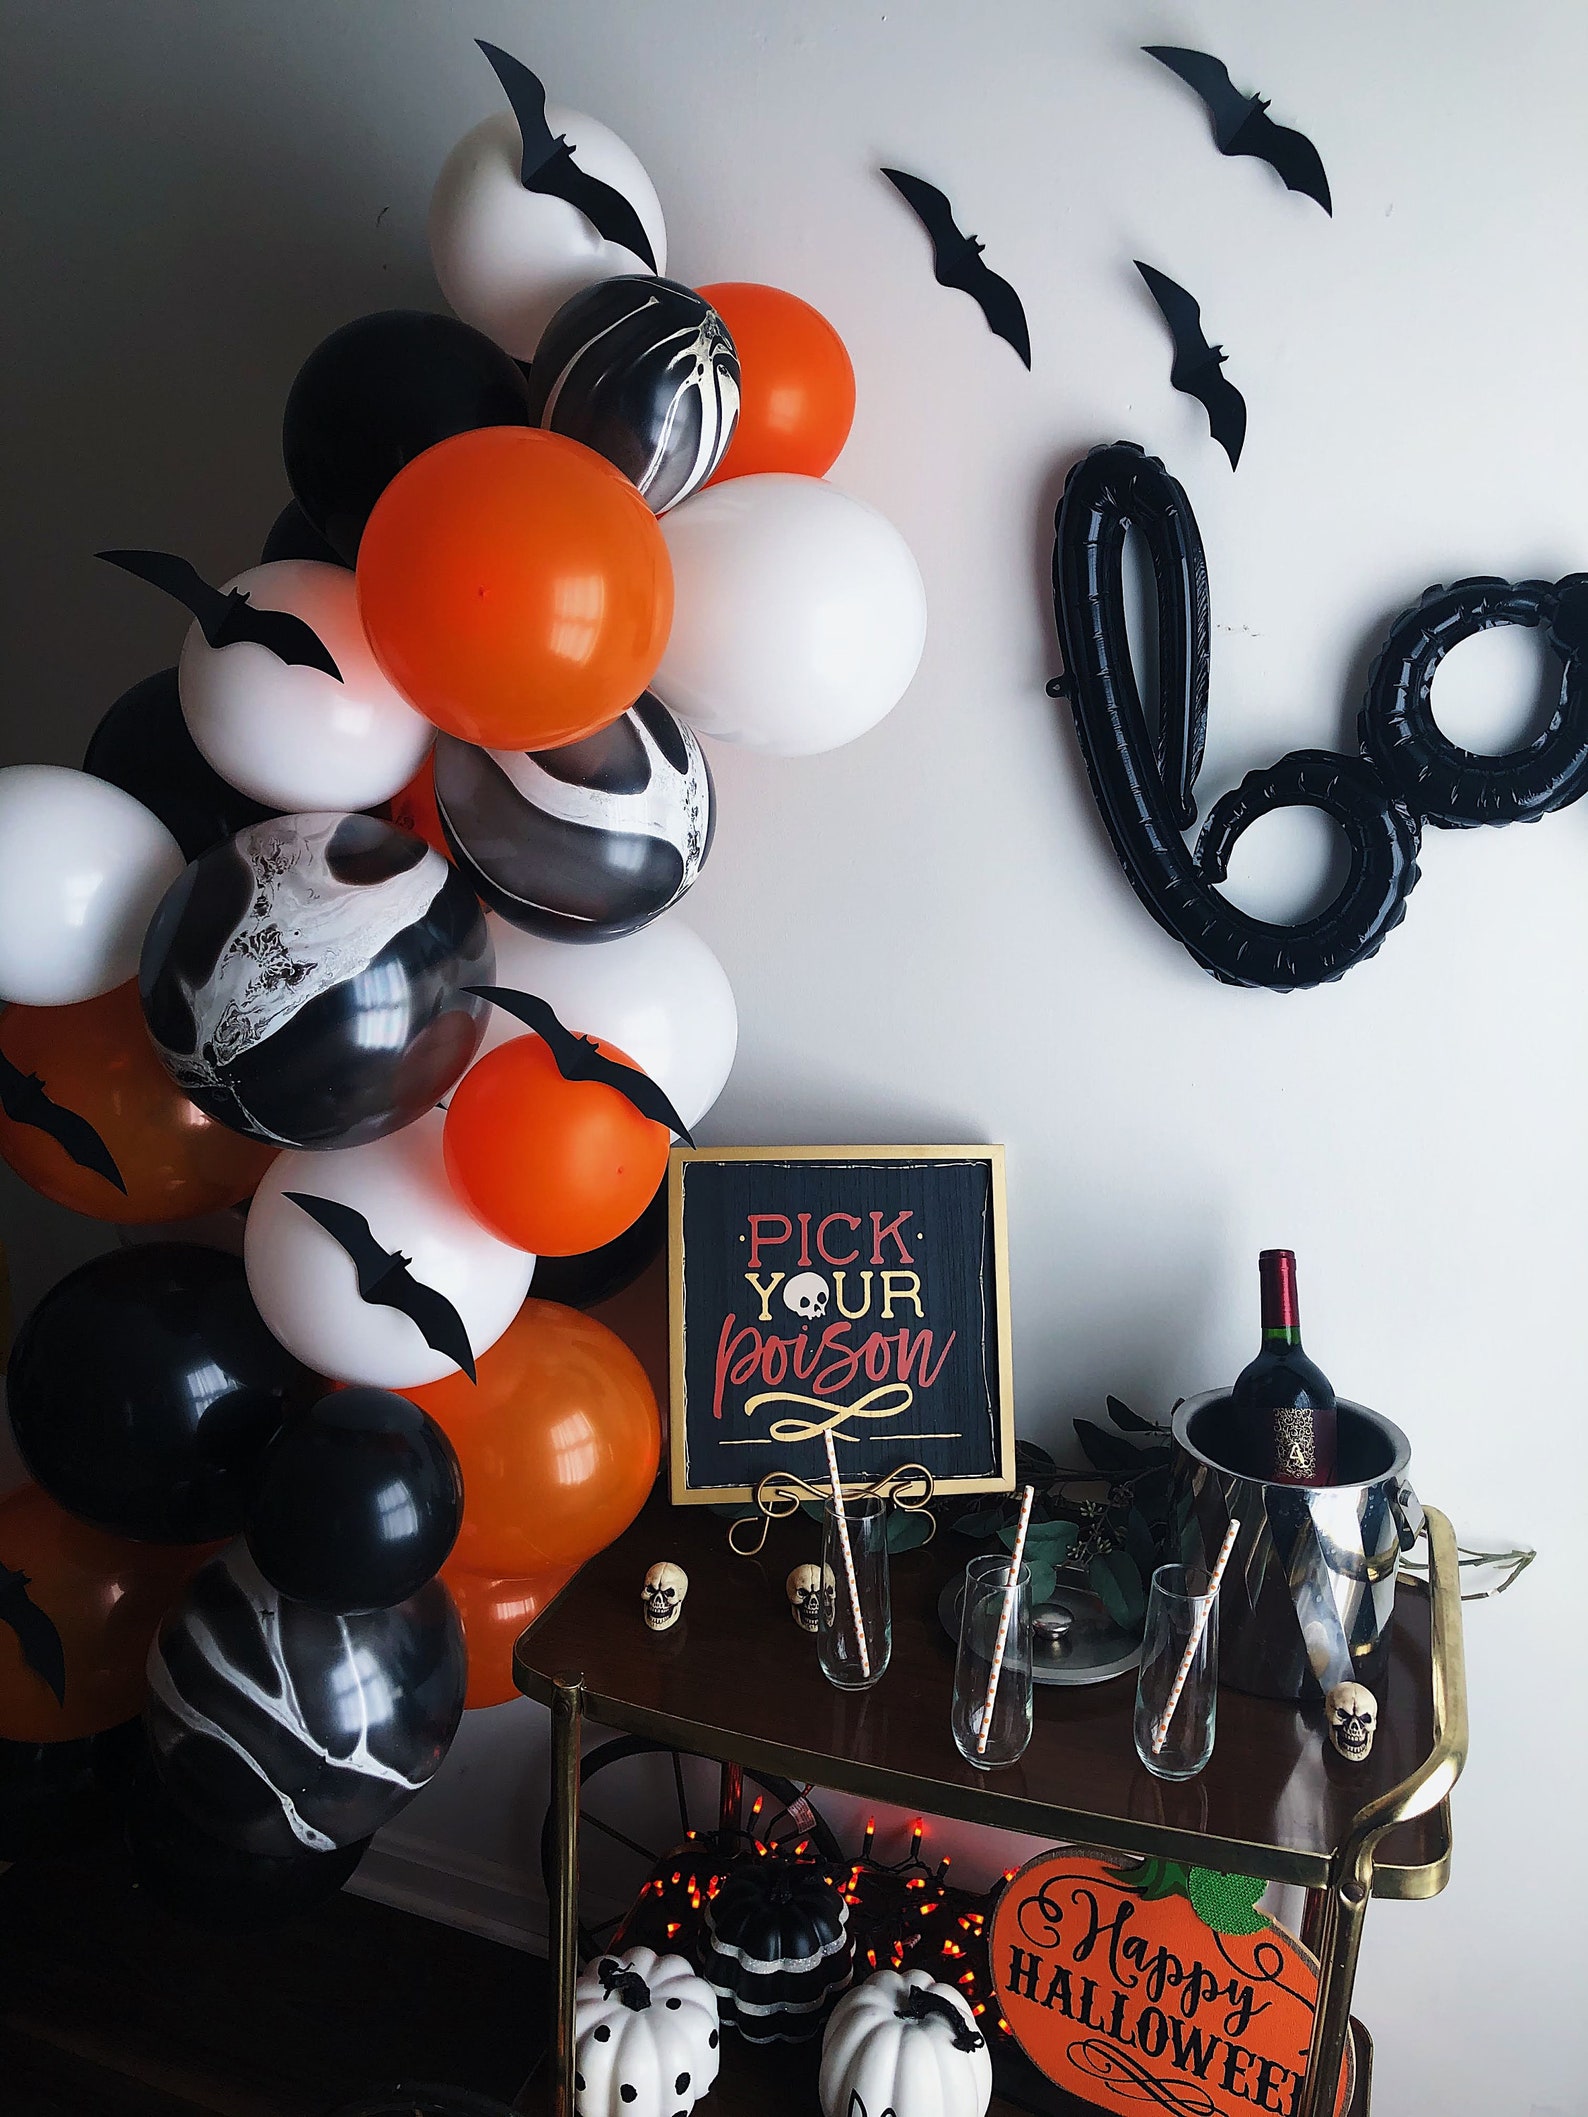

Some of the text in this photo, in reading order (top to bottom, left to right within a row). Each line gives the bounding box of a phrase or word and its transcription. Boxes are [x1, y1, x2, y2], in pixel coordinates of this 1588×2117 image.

[747, 1210, 915, 1267] PICK
[712, 1313, 956, 1419] poison
[1071, 1888, 1272, 2037] Happy
